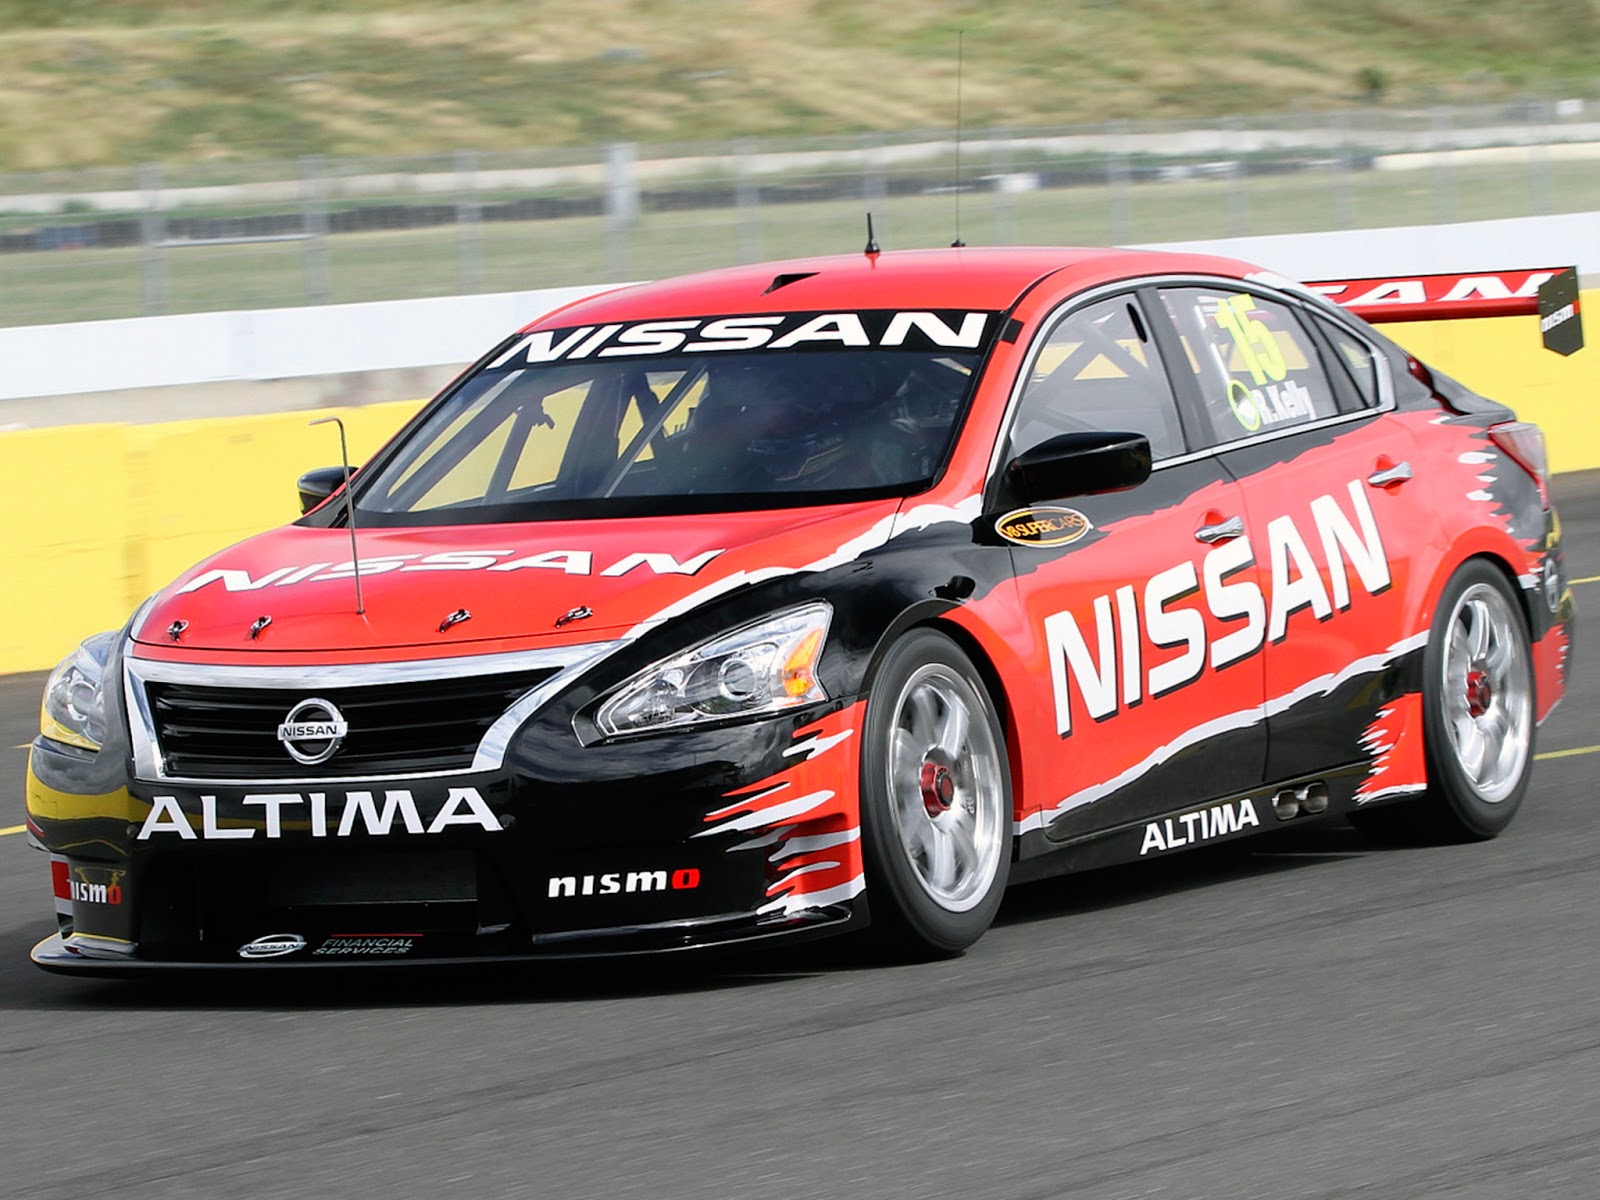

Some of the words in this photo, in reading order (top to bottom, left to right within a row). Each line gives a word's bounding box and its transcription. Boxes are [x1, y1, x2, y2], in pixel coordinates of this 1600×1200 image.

[486, 312, 987, 369] NISSAN
[1215, 293, 1286, 385] 15
[176, 549, 726, 592] NISSAN
[1044, 479, 1392, 740] NISSAN
[283, 725, 337, 737] NISSAN
[137, 787, 502, 840] ALTIMA
[1140, 798, 1260, 855] ALTIMA
[548, 868, 700, 898] nismo
[247, 941, 297, 952] NISSAN
[312, 947, 410, 955] SERVICES
[322, 938, 414, 947] FINANCIAL
